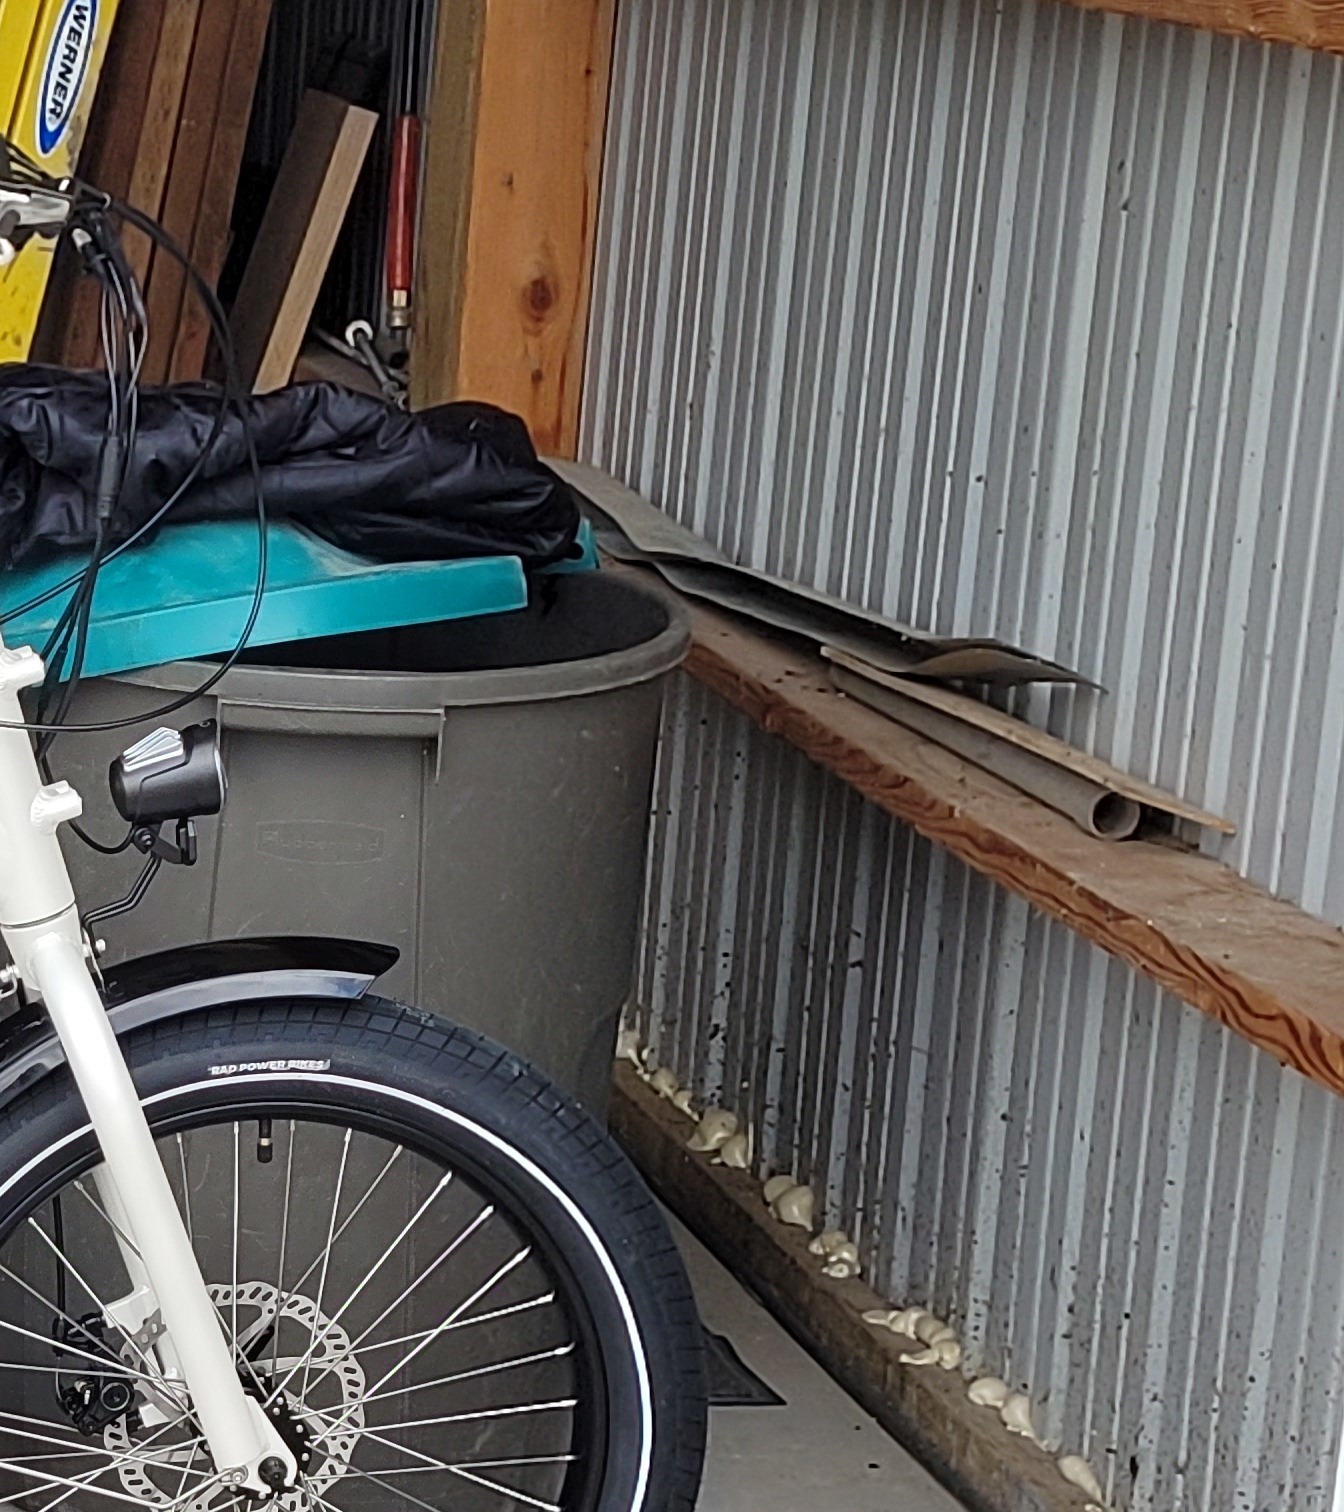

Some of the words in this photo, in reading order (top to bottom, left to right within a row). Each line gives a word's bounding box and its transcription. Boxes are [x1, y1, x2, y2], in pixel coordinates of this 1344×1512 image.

[48, 4, 89, 120] WERNER
[210, 1065, 237, 1076] RAD
[239, 1060, 286, 1072] POWER
[287, 1059, 325, 1071] BIKES
